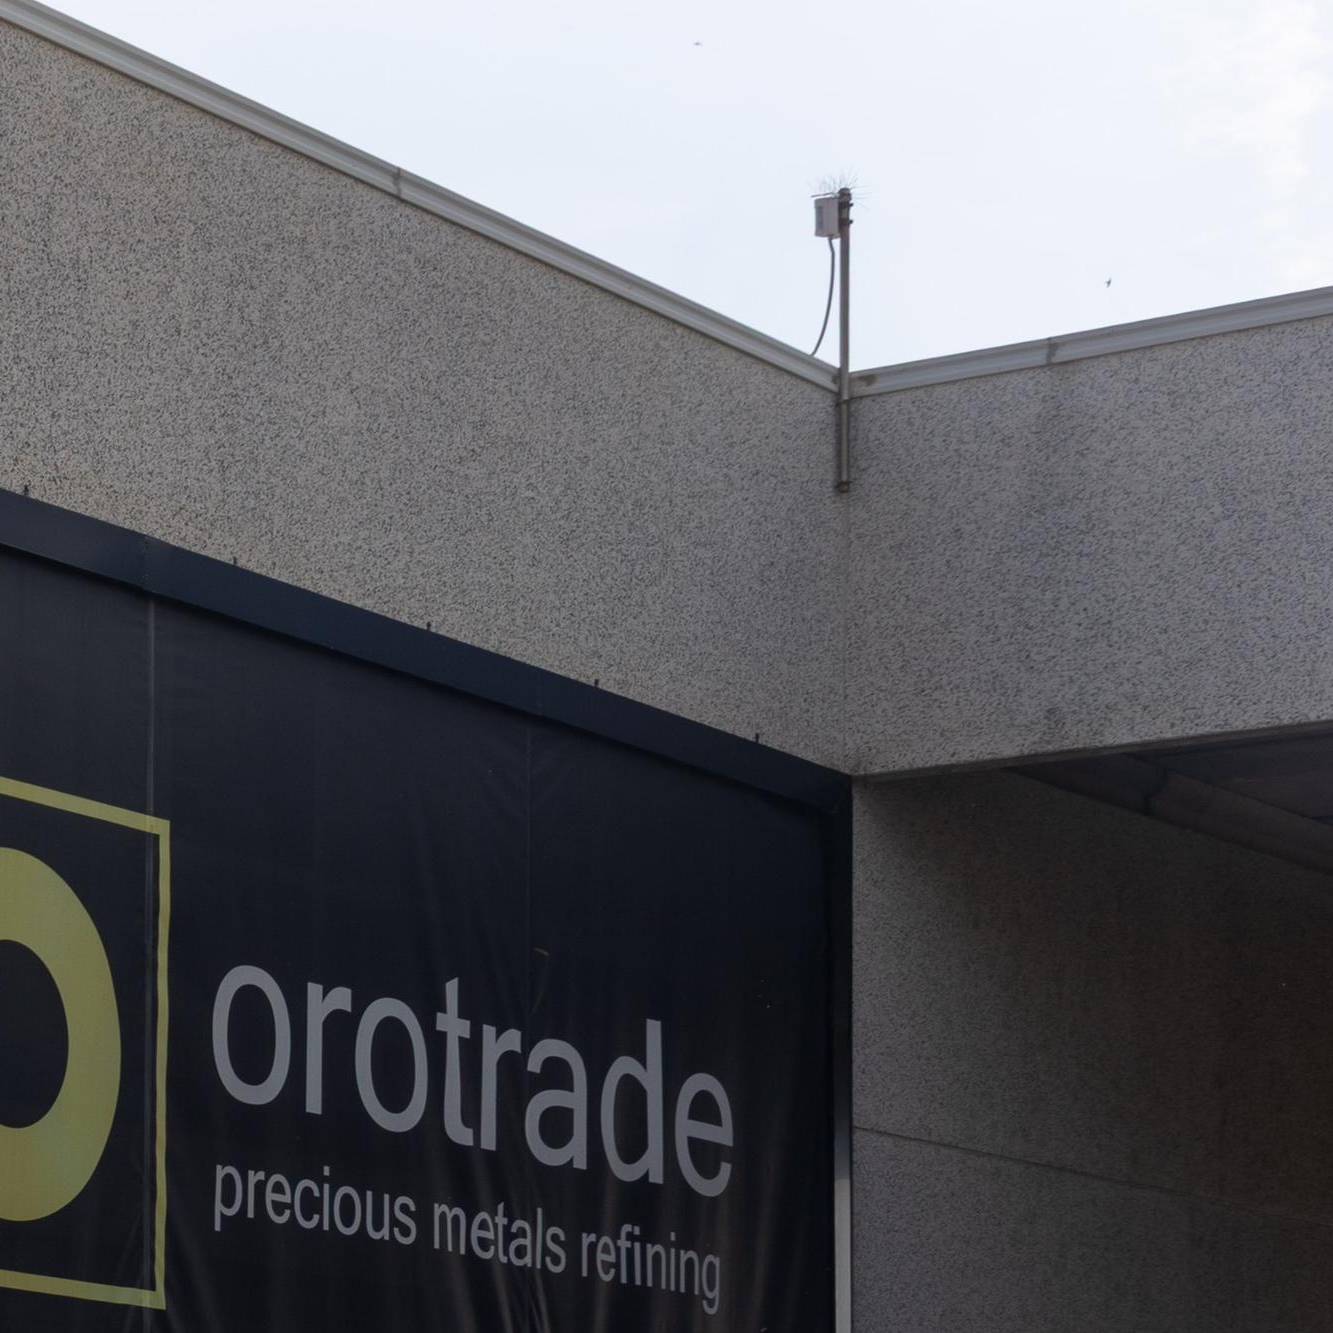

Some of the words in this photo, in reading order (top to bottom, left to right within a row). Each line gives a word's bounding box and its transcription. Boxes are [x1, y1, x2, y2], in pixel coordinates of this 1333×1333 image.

[211, 964, 734, 1198] orotrade
[214, 1163, 417, 1245] precious
[433, 1201, 566, 1273] metals
[581, 1224, 721, 1315] refining
